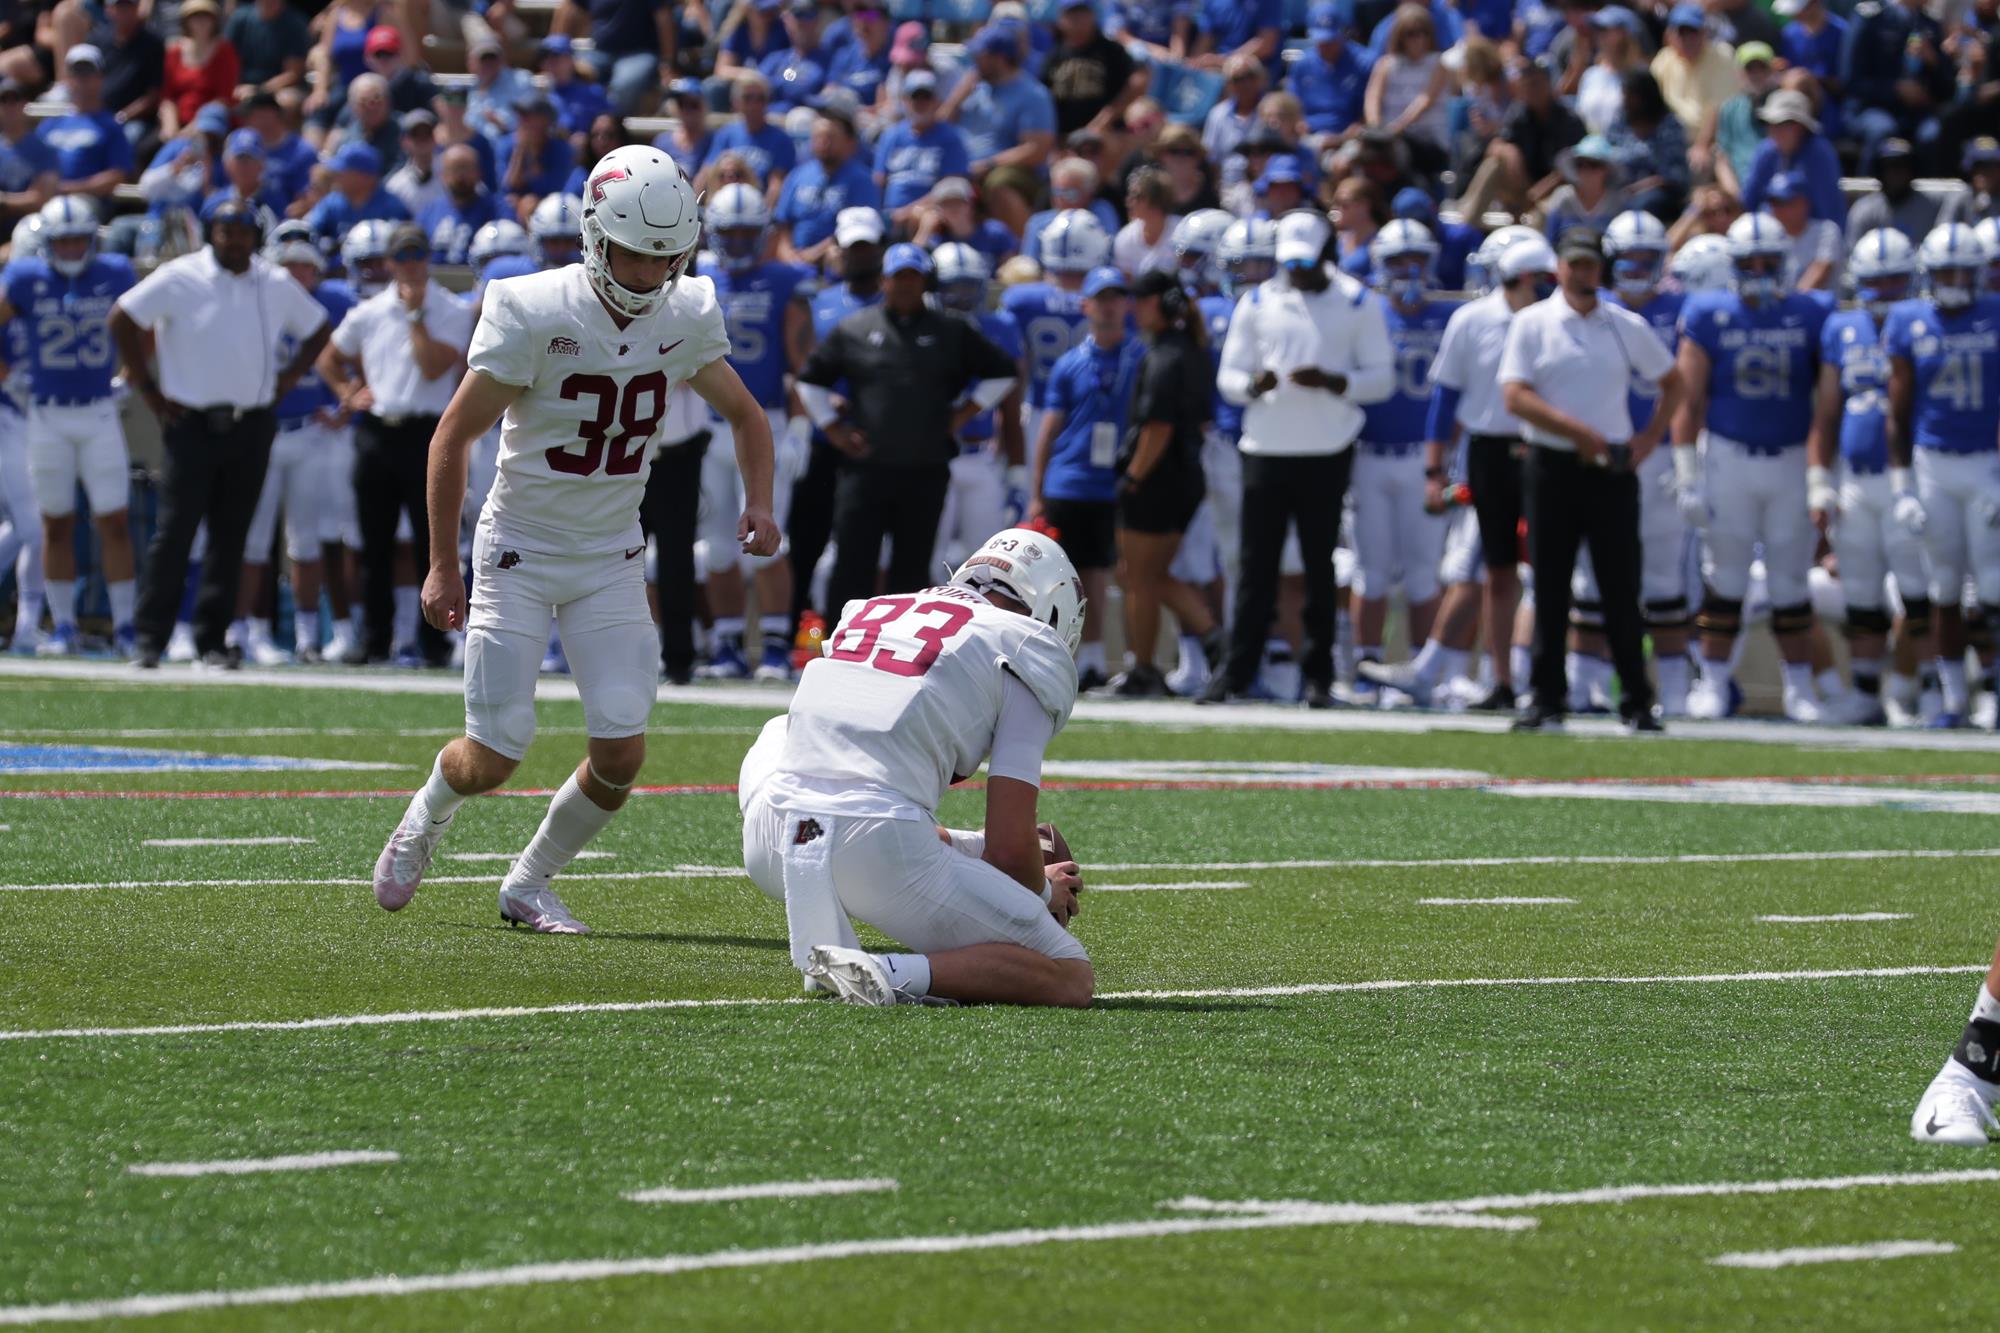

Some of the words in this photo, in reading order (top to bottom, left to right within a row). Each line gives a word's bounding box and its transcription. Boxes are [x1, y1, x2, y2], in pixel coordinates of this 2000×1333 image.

[38, 315, 112, 370] 23
[1733, 345, 1790, 399] 61
[1927, 351, 1984, 411] 41
[545, 370, 668, 476] 38
[829, 597, 974, 678] 83
